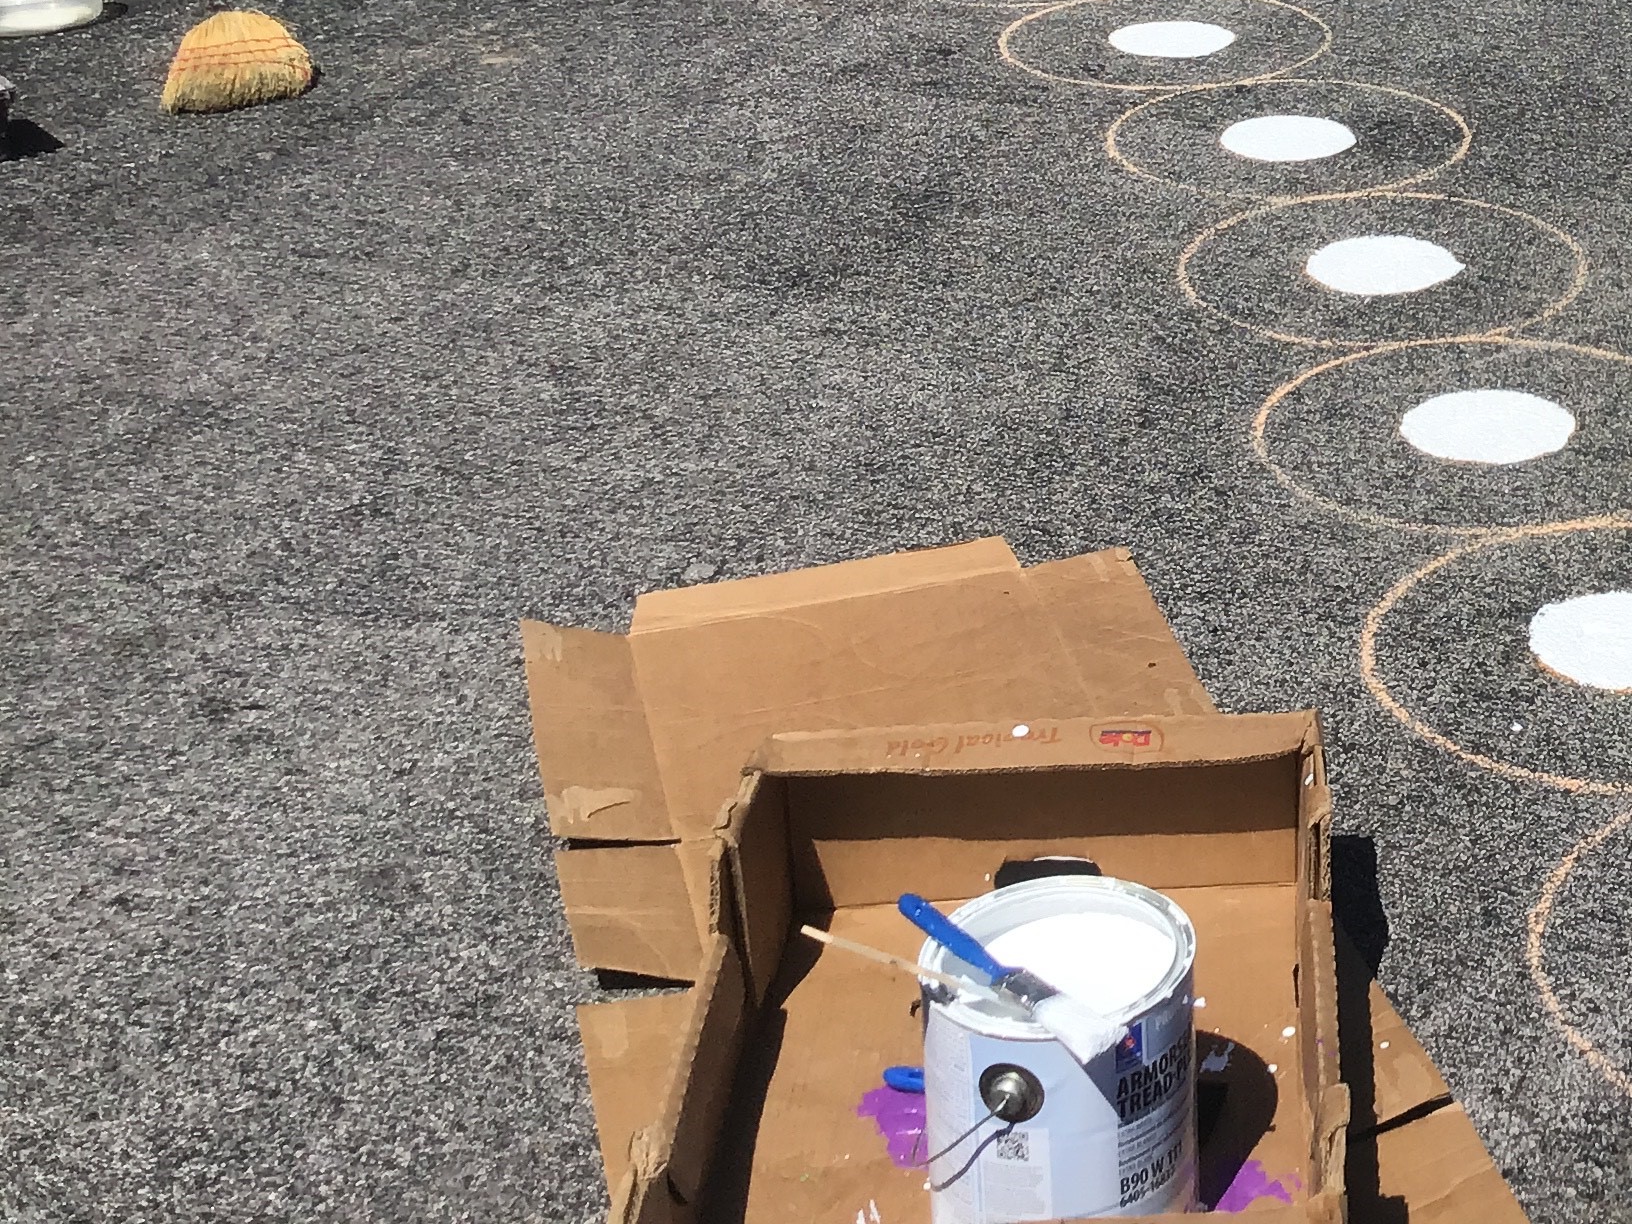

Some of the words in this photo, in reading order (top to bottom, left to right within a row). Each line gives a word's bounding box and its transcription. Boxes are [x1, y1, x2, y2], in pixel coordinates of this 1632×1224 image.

[886, 737, 949, 756] Gold
[1100, 732, 1151, 747] Dole
[1120, 1168, 1148, 1194] B90
[1151, 1156, 1164, 1177] W
